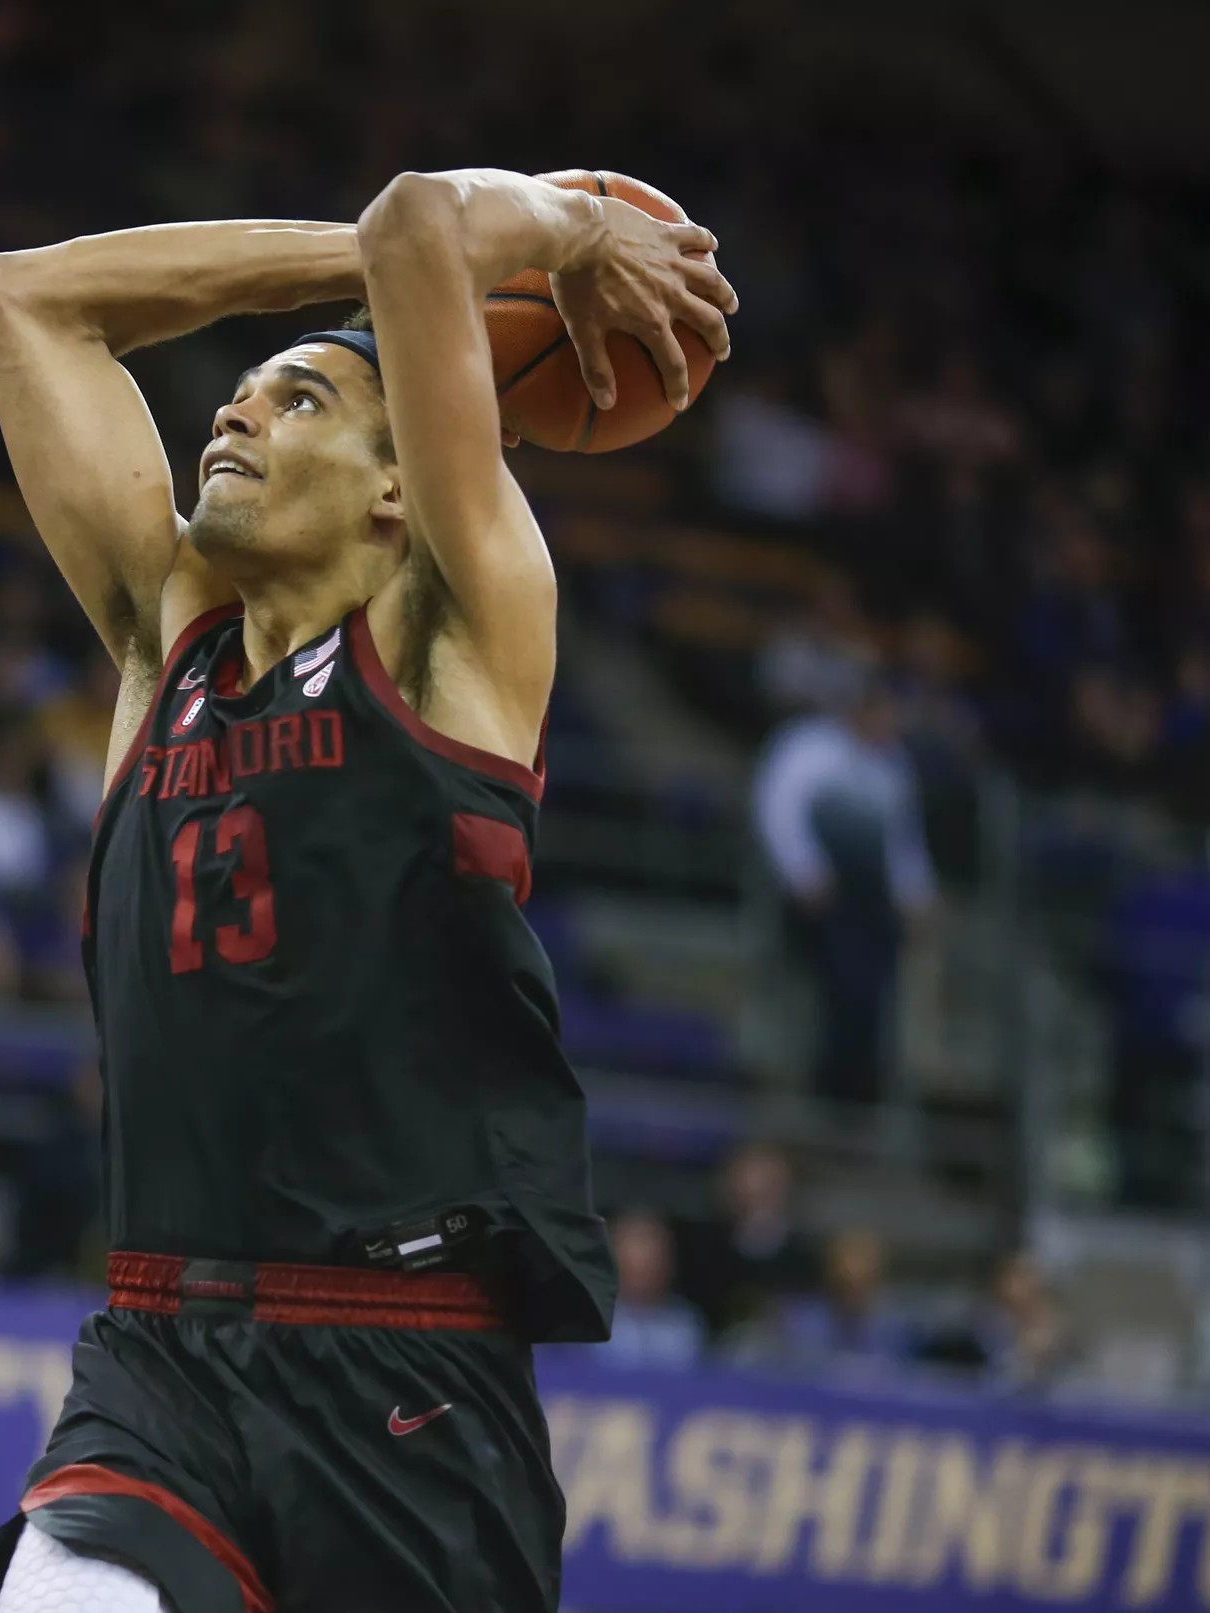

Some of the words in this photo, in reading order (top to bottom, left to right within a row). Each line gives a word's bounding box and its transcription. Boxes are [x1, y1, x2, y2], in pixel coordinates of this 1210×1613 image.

[139, 709, 345, 800] STANORD
[170, 806, 277, 975] 13
[446, 1214, 467, 1233] 50
[548, 1394, 1210, 1612] ASHINGT
